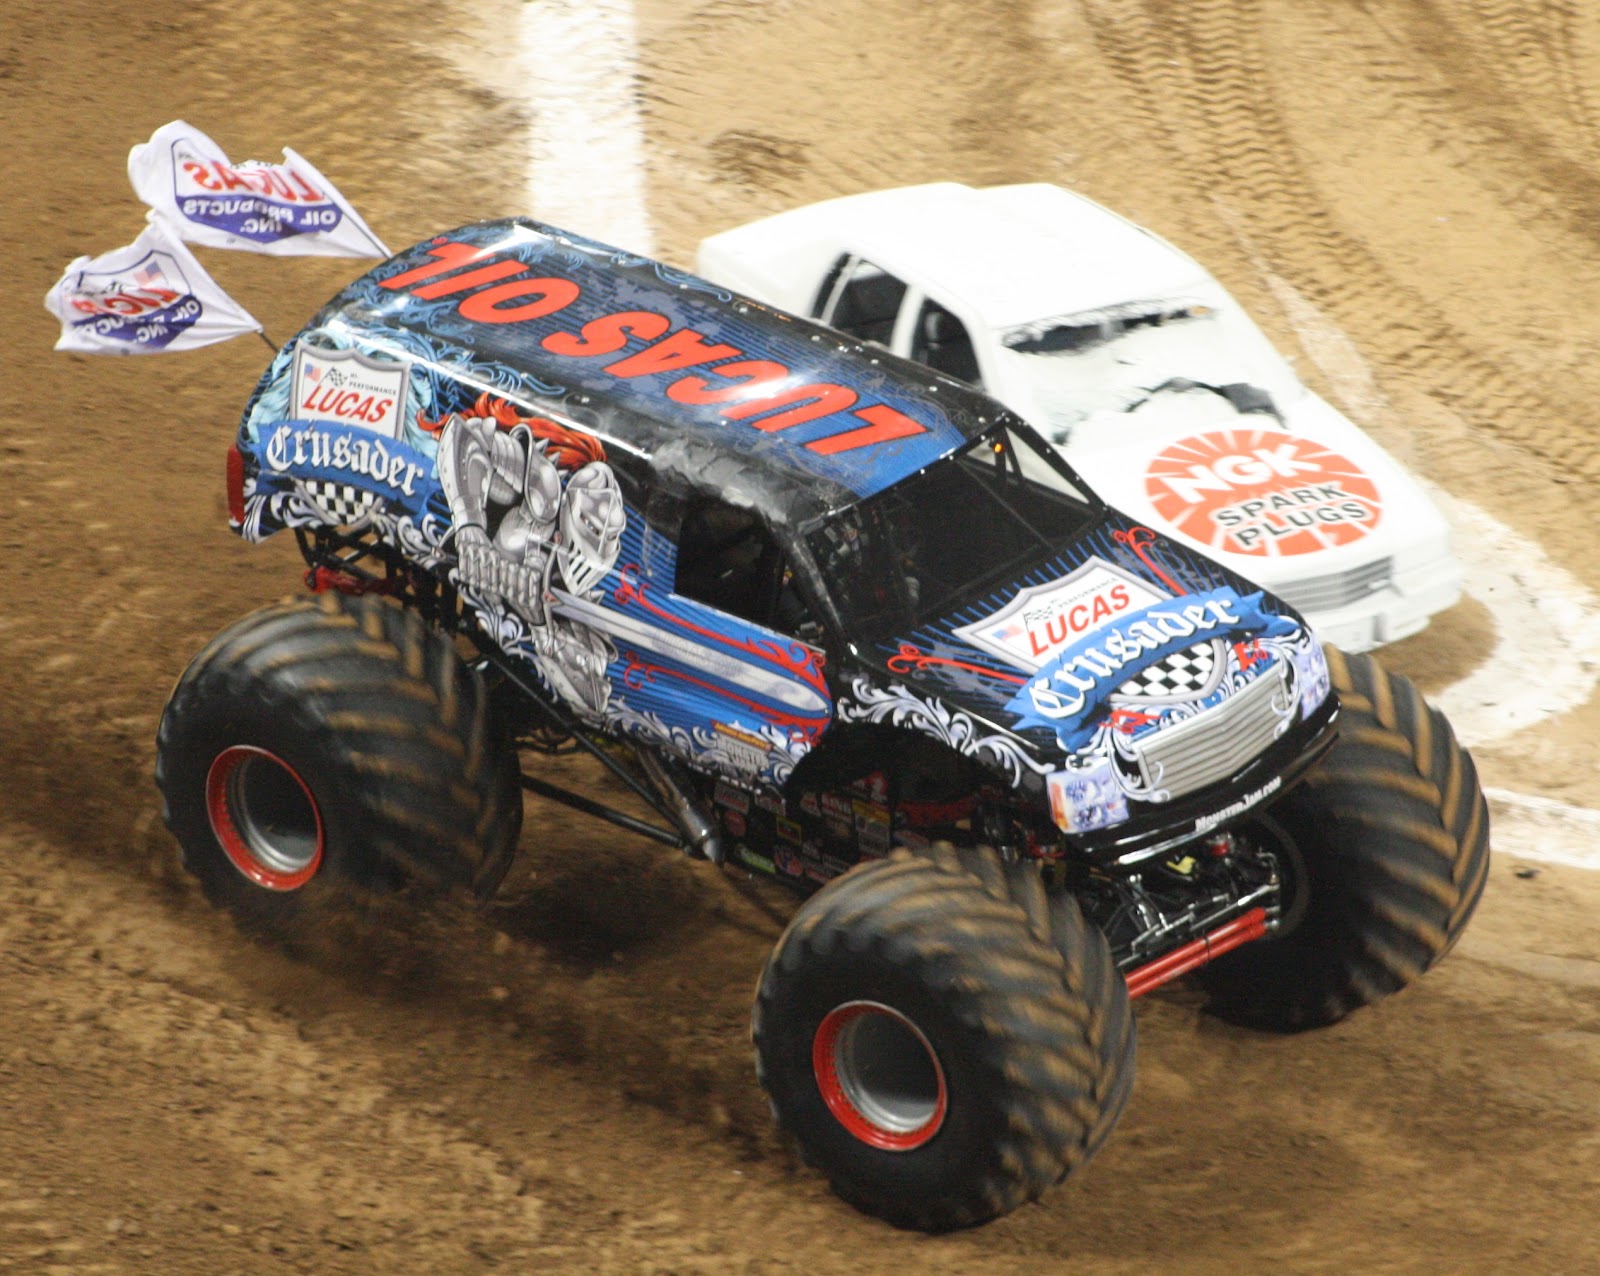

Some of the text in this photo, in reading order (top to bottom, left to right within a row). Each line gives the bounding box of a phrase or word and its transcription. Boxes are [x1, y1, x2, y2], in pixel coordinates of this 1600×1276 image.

[377, 241, 928, 456] LUCAS OIL
[302, 385, 393, 423] LUCAS
[266, 425, 424, 496] Crusader
[1159, 443, 1322, 504] NGK
[1216, 484, 1347, 527] SPARK
[1235, 502, 1368, 547] PLUGS
[1029, 584, 1130, 658] LUCAS
[1028, 596, 1242, 720] Crusader
